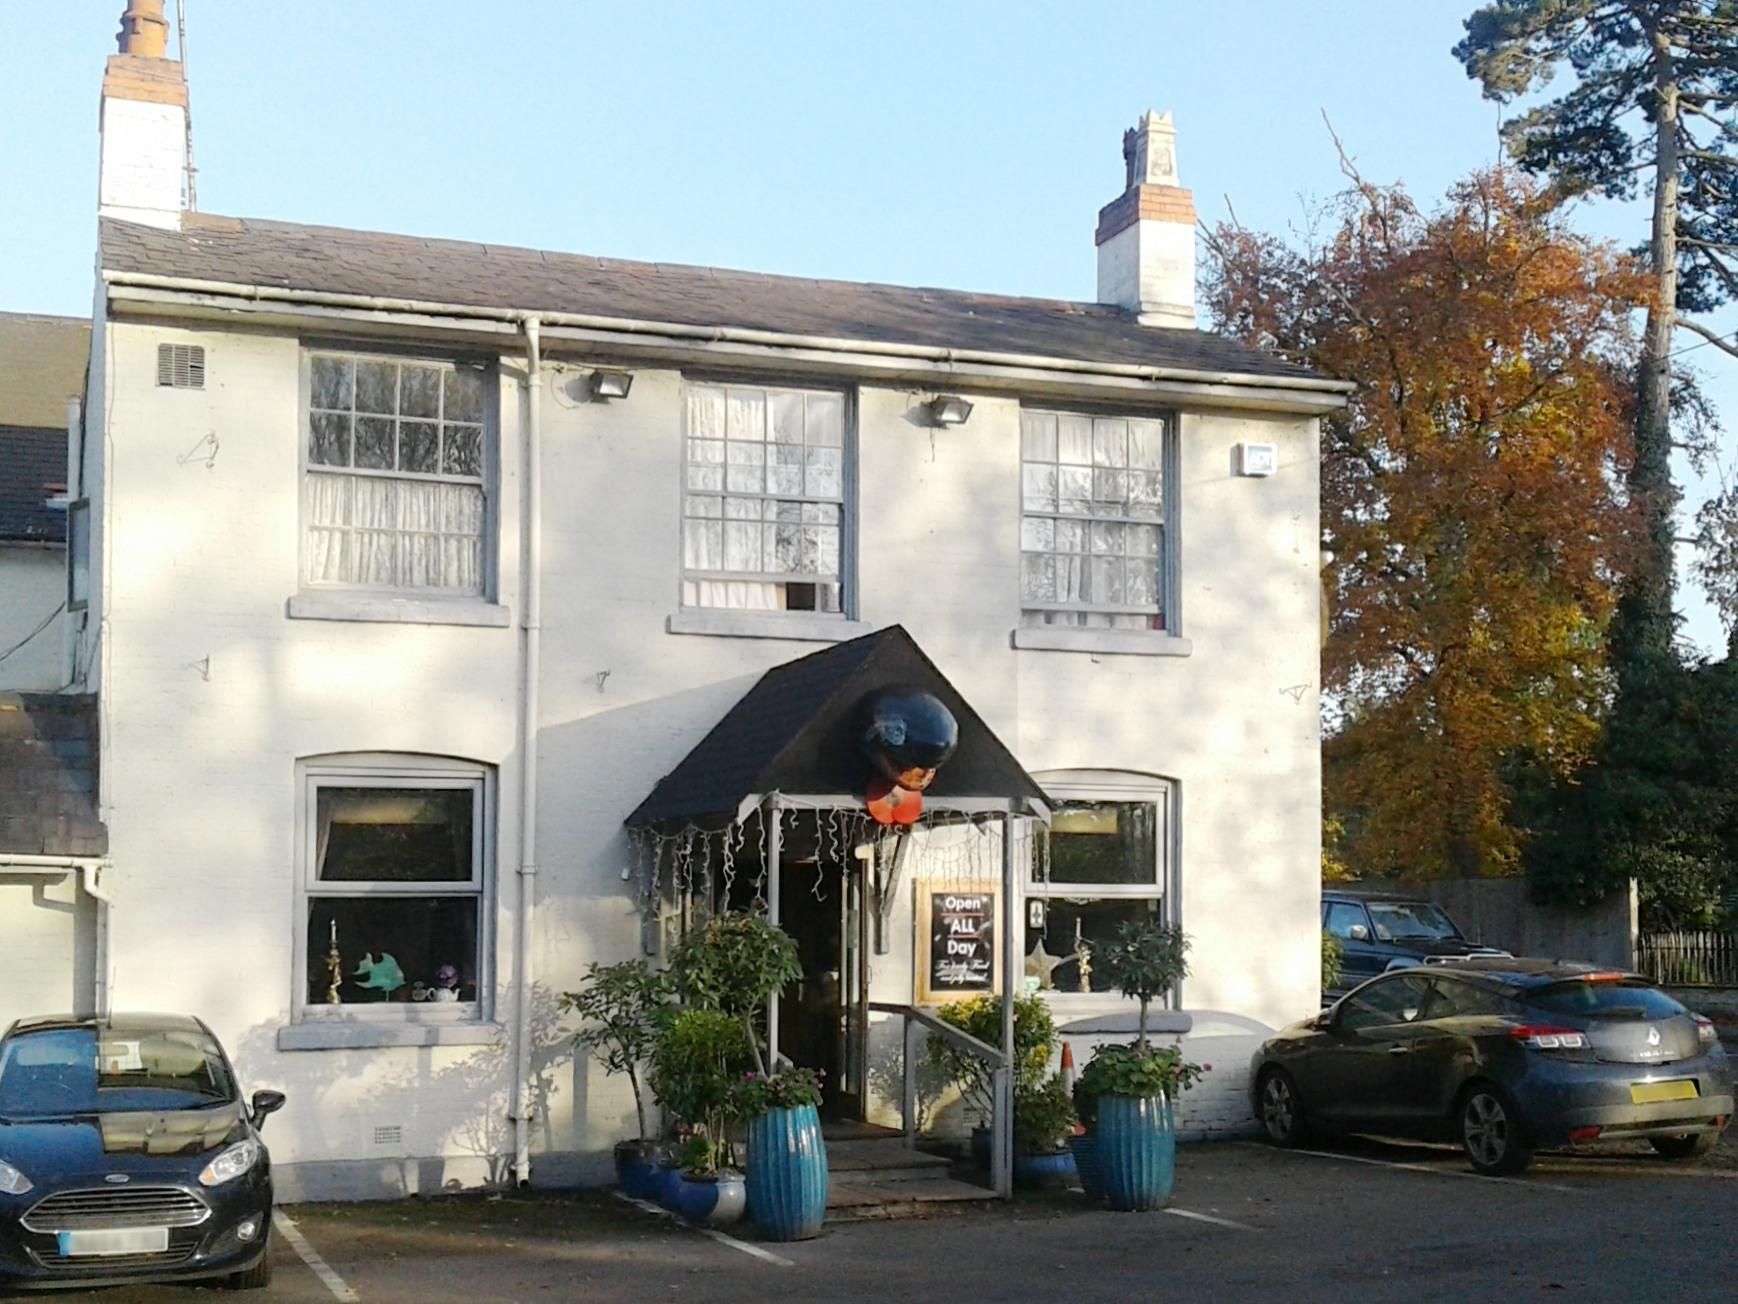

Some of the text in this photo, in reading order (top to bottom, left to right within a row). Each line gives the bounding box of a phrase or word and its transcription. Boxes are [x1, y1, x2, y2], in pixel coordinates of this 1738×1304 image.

[945, 896, 981, 912] Open
[950, 918, 976, 934] ALL
[947, 940, 977, 958] Day
